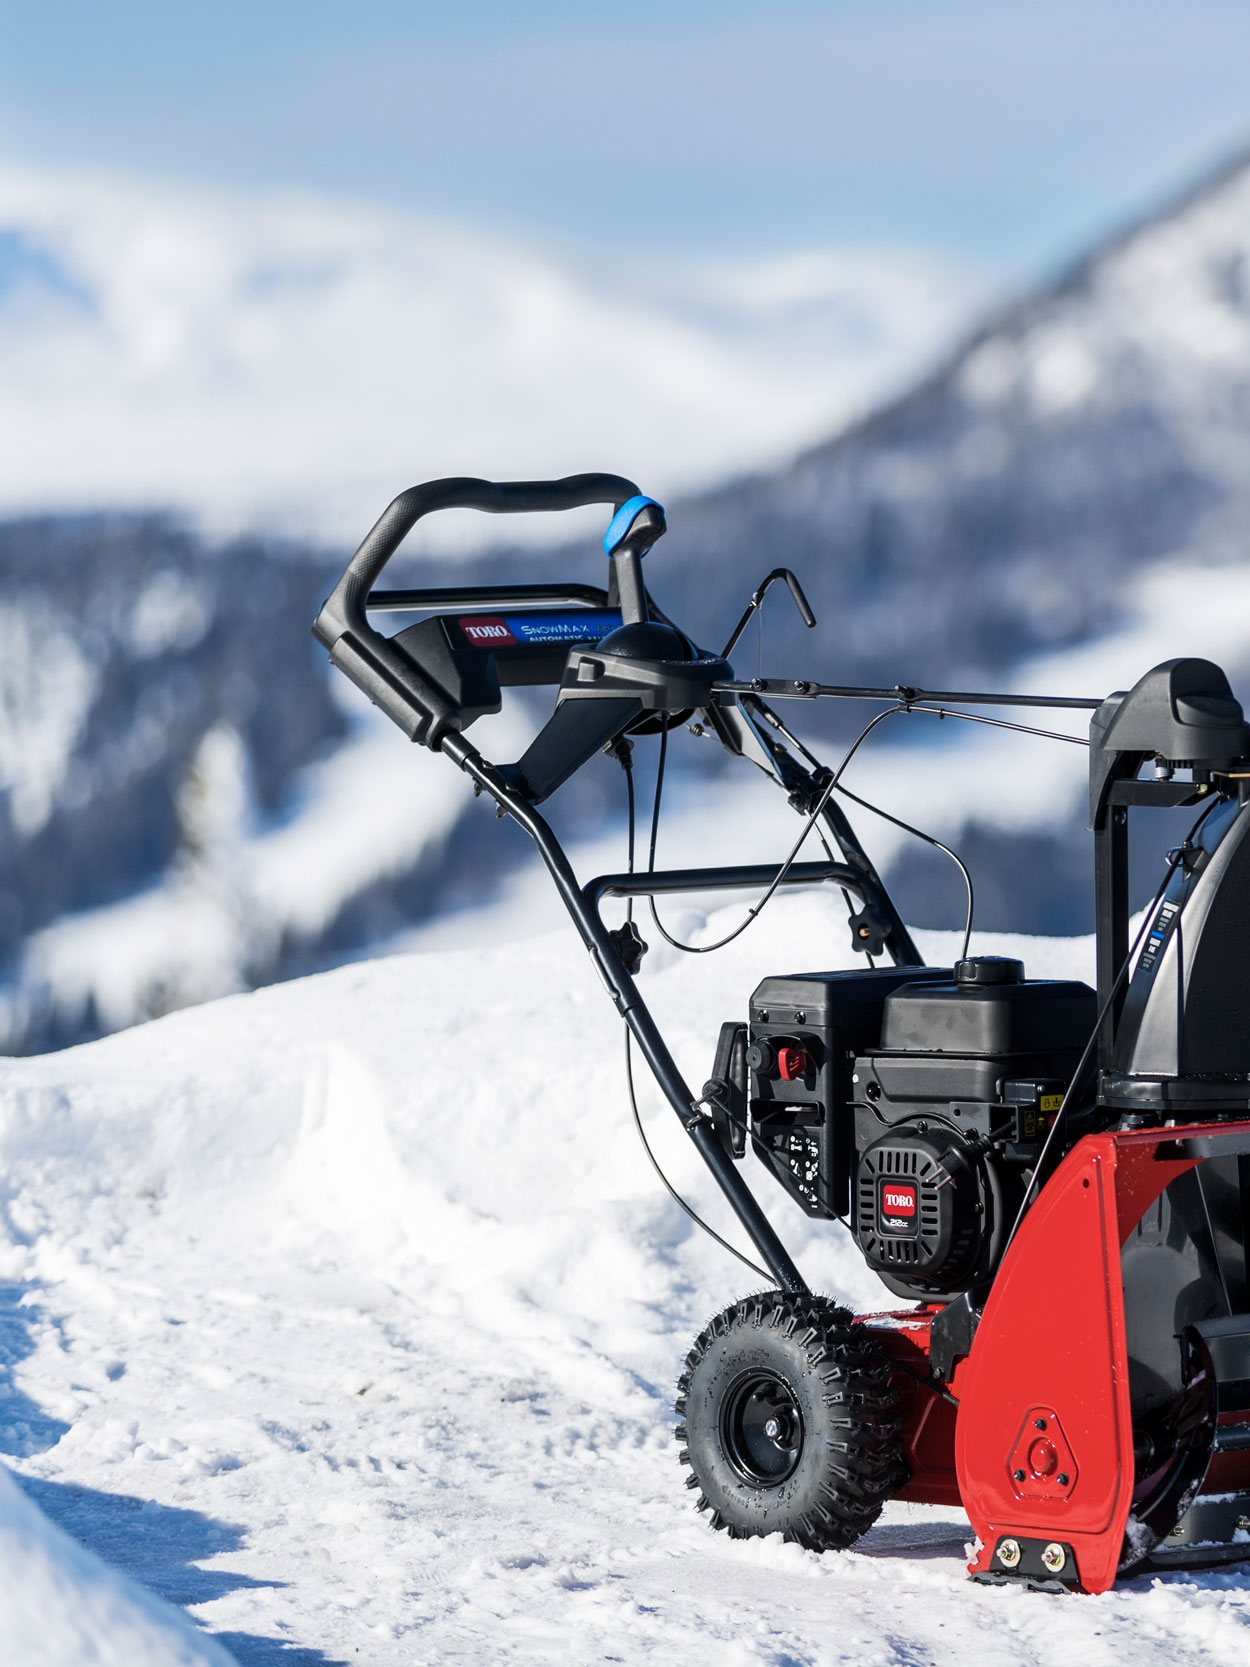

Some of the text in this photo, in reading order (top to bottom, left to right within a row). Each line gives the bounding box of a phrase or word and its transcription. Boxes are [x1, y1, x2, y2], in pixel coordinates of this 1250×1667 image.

[465, 625, 508, 639] TORO
[529, 634, 584, 642] AUTOMATIC
[886, 1194, 913, 1207] TORO
